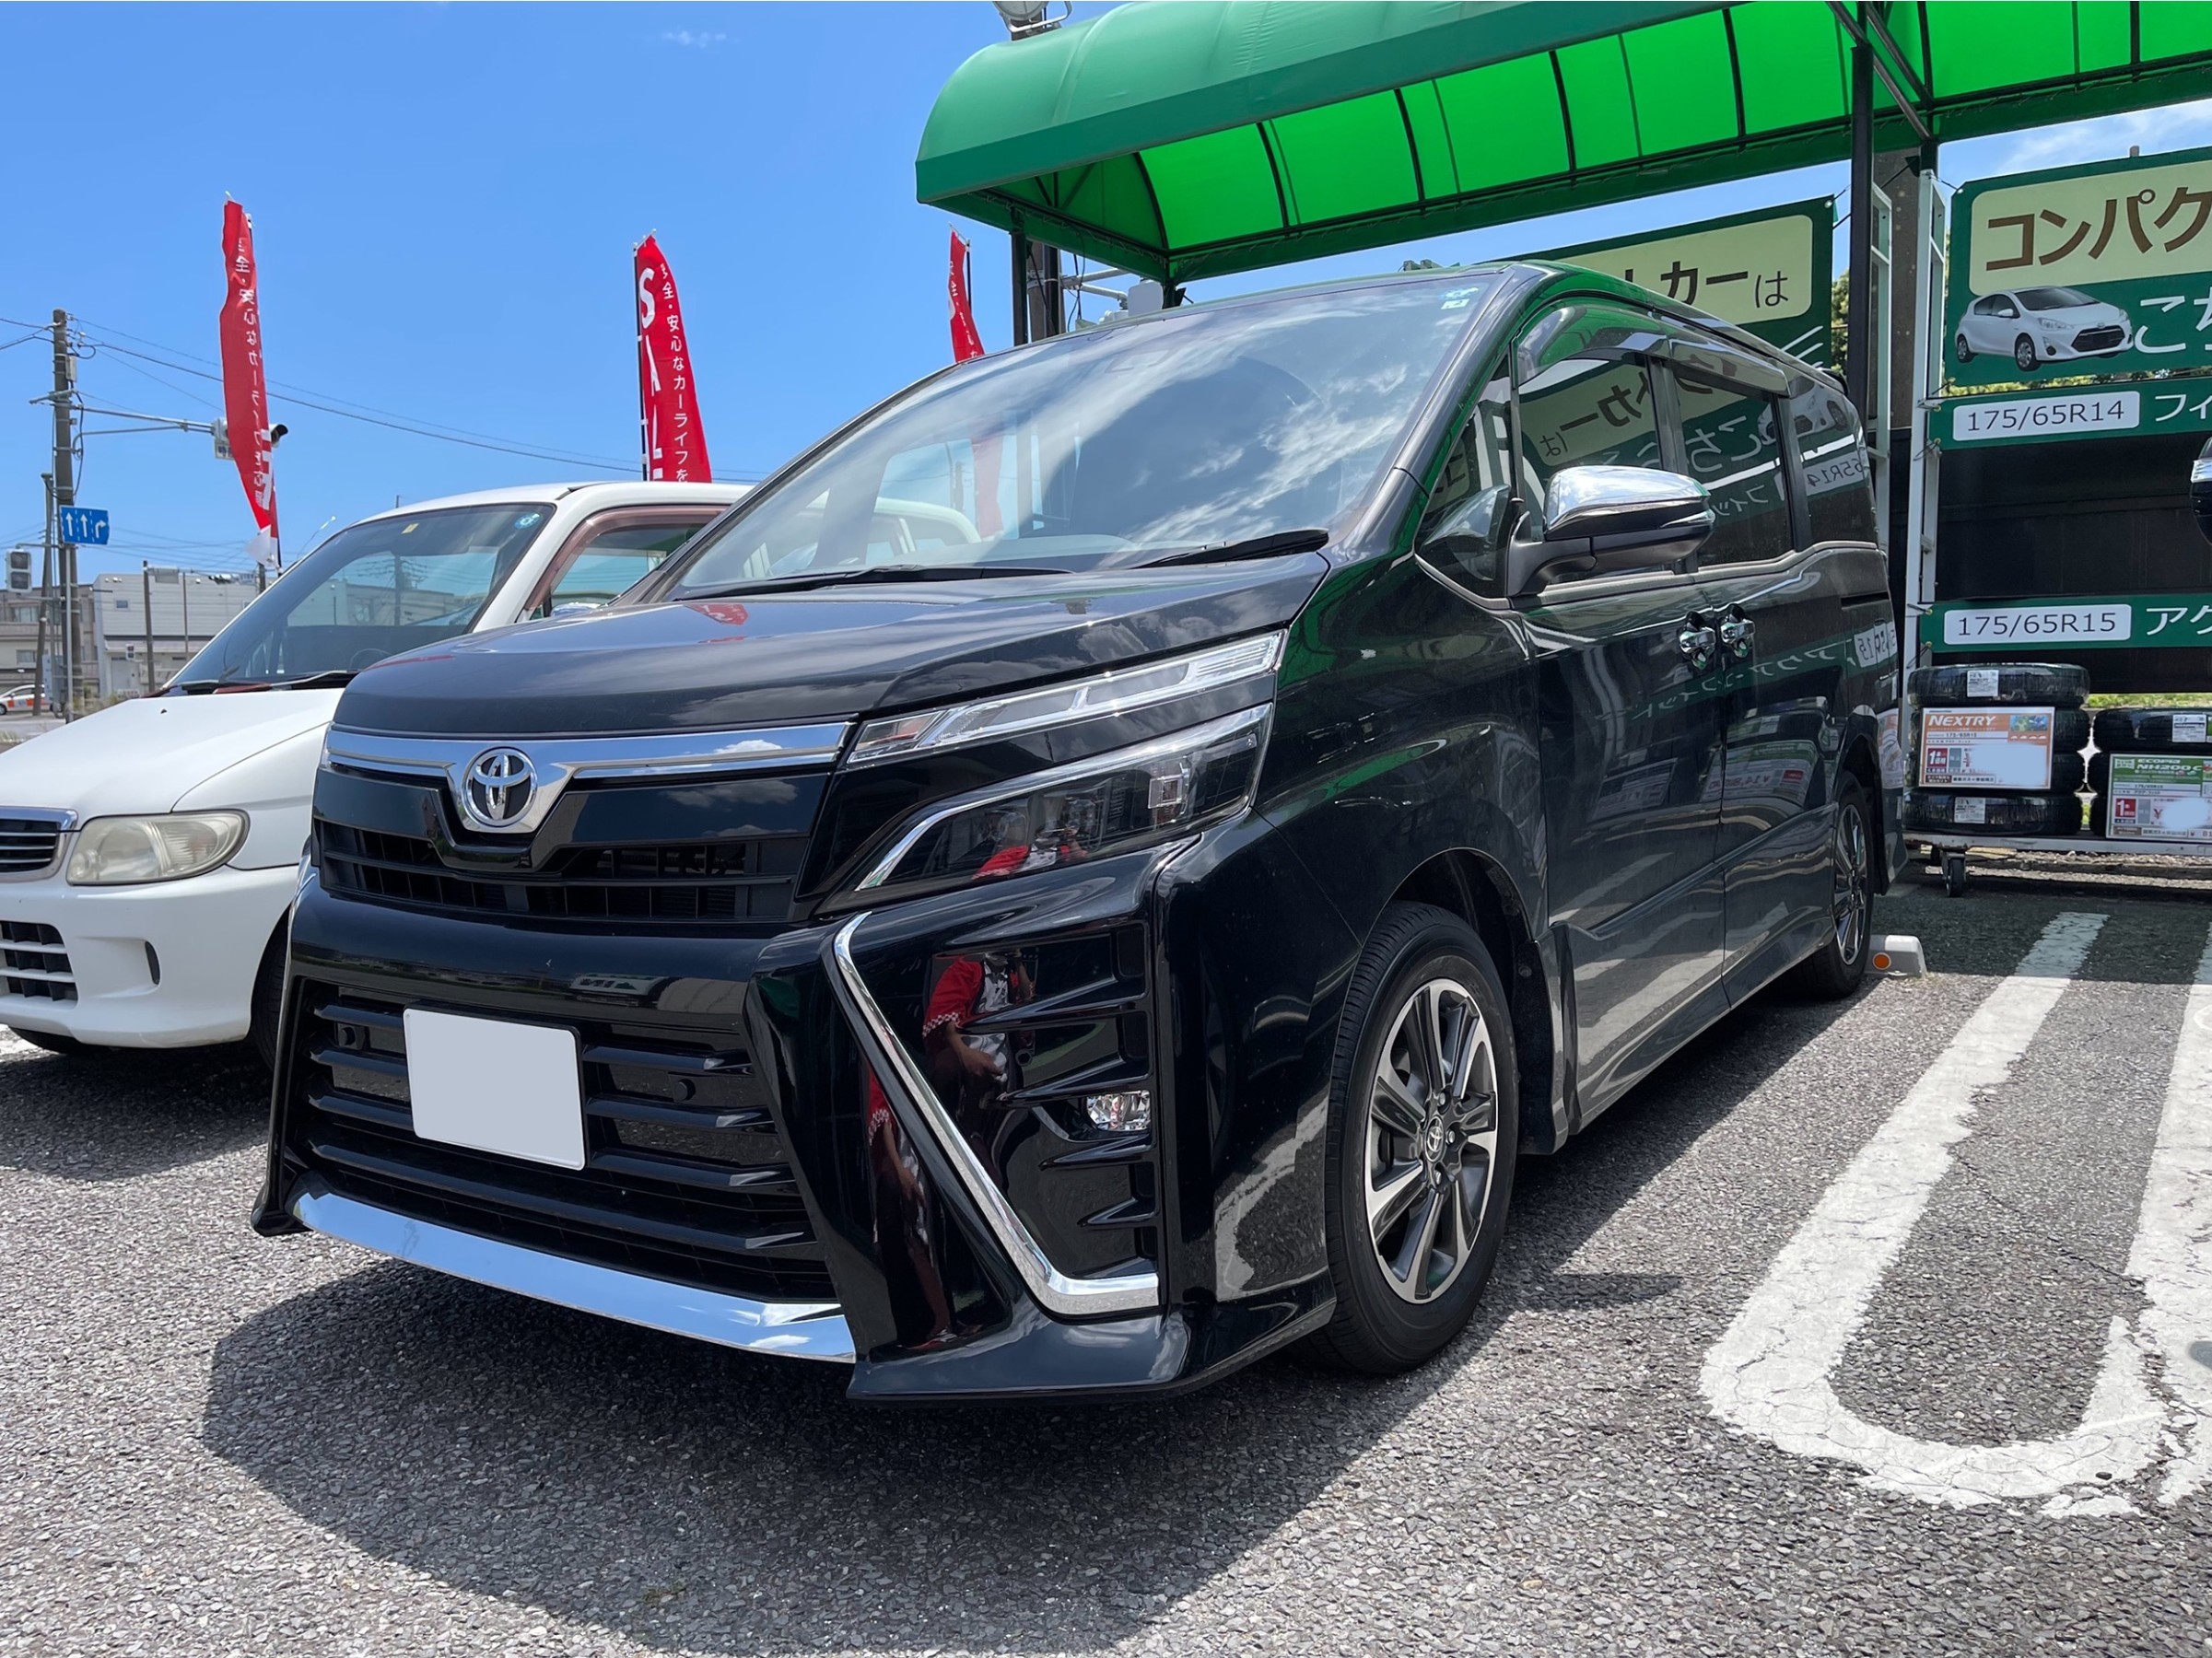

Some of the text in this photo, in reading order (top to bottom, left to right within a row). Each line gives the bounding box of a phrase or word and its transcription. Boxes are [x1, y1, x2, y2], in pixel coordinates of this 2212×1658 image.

[1986, 187, 2212, 271] コンパク
[1967, 400, 2124, 431] 175/65R14
[1958, 613, 2116, 637] 175/65R15
[1928, 715, 1996, 726] NEXTRY
